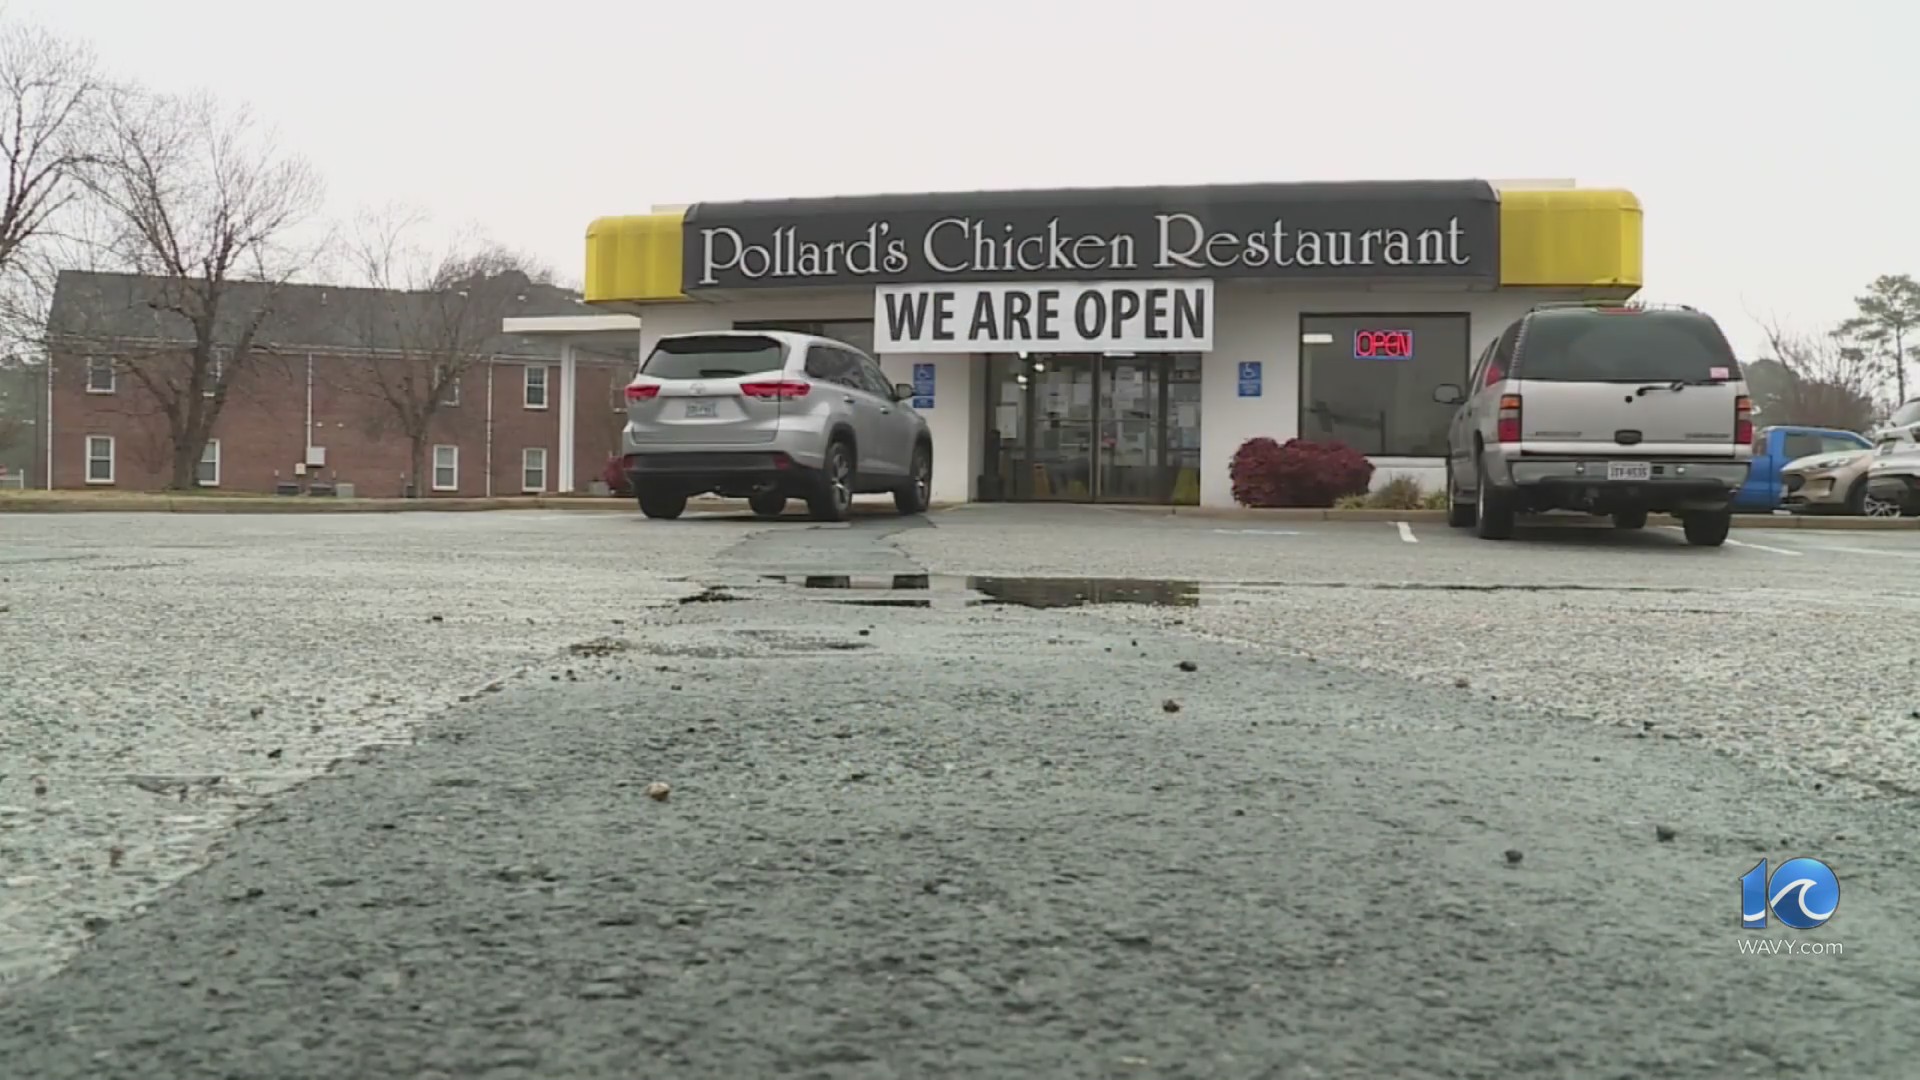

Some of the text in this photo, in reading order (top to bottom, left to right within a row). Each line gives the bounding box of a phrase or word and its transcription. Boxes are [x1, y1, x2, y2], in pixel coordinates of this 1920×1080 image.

[699, 213, 1471, 286] Pollard's Chicken Restaurant
[885, 288, 1205, 341] WE ARE OPEN
[1356, 331, 1411, 357] OPEN
